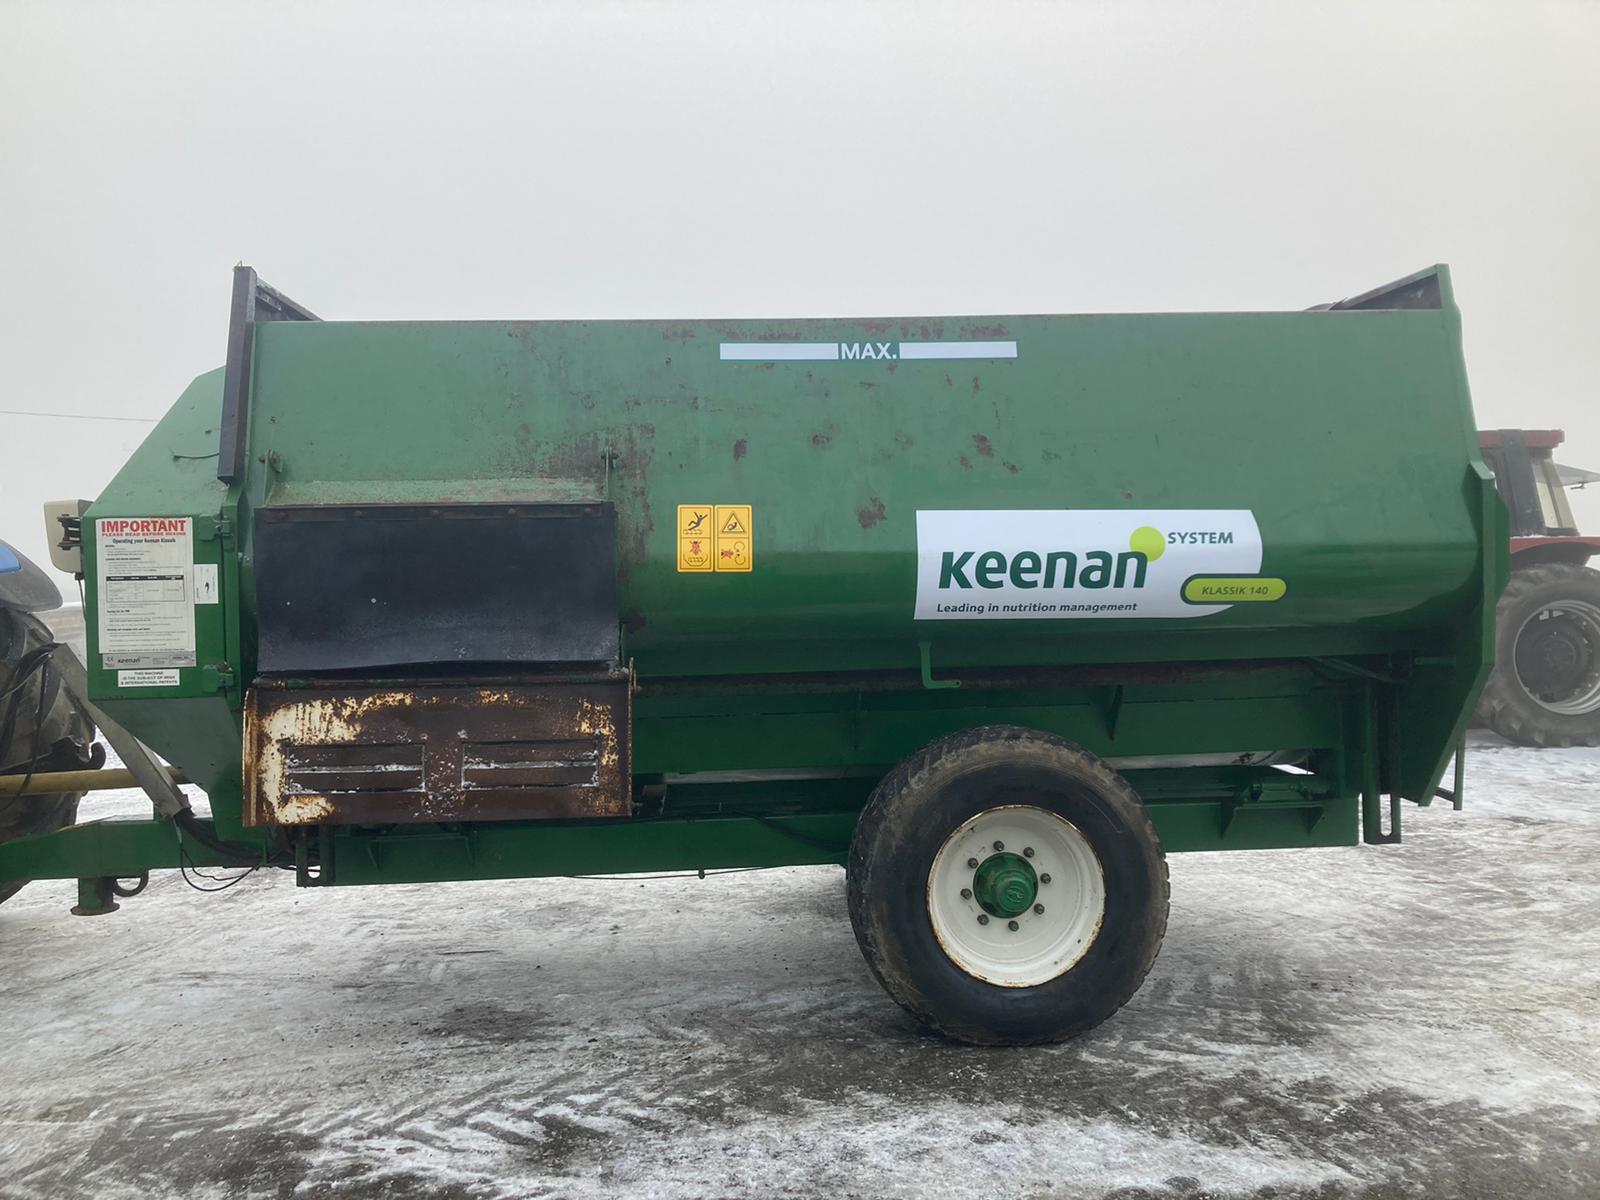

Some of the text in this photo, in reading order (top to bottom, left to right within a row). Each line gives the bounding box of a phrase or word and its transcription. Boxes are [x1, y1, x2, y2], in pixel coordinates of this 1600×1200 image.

[841, 343, 897, 359] MAX.
[101, 520, 186, 532] IMPORTANT
[1167, 531, 1234, 545] SYSTEM
[1201, 585, 1269, 596] KLASSIK 140
[937, 602, 1137, 614] Leading in nutrition management
